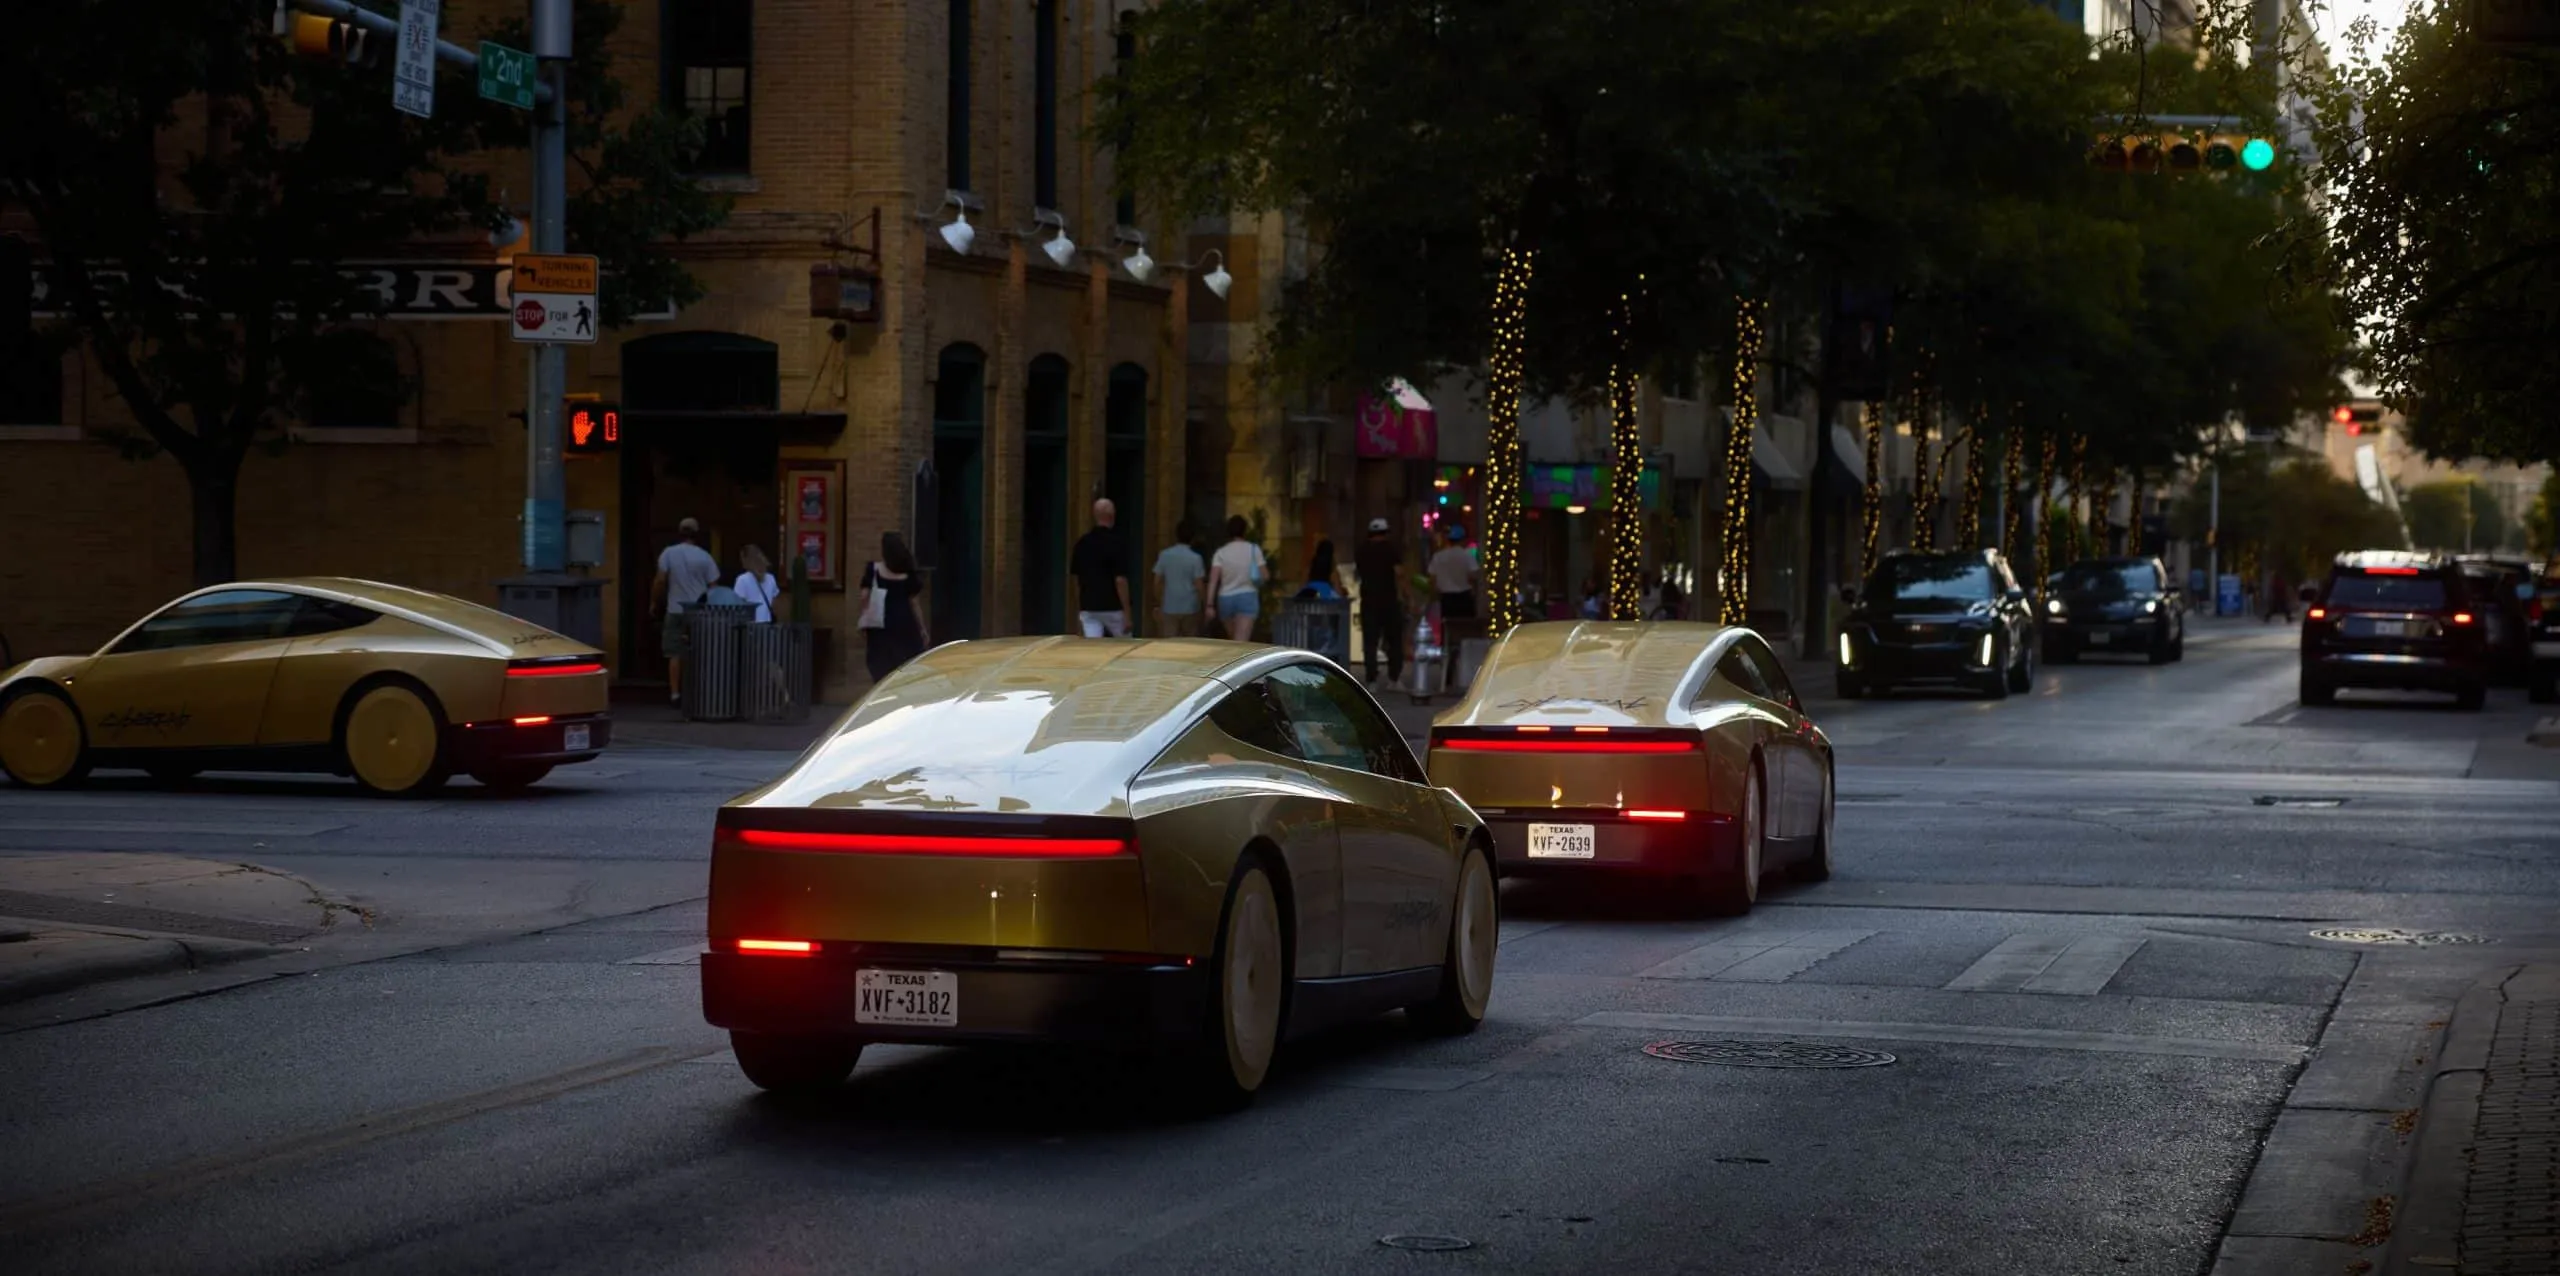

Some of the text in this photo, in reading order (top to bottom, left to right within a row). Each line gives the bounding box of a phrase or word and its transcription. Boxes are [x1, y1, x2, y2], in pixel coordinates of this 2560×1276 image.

[496, 50, 523, 87] 2nd
[541, 261, 592, 274] TURNING
[337, 269, 512, 309] BR
[537, 276, 592, 290] VEHICLES
[516, 308, 568, 322] STOP FOR
[1550, 826, 1574, 834] TEXAS
[888, 974, 926, 986] TEXAS
